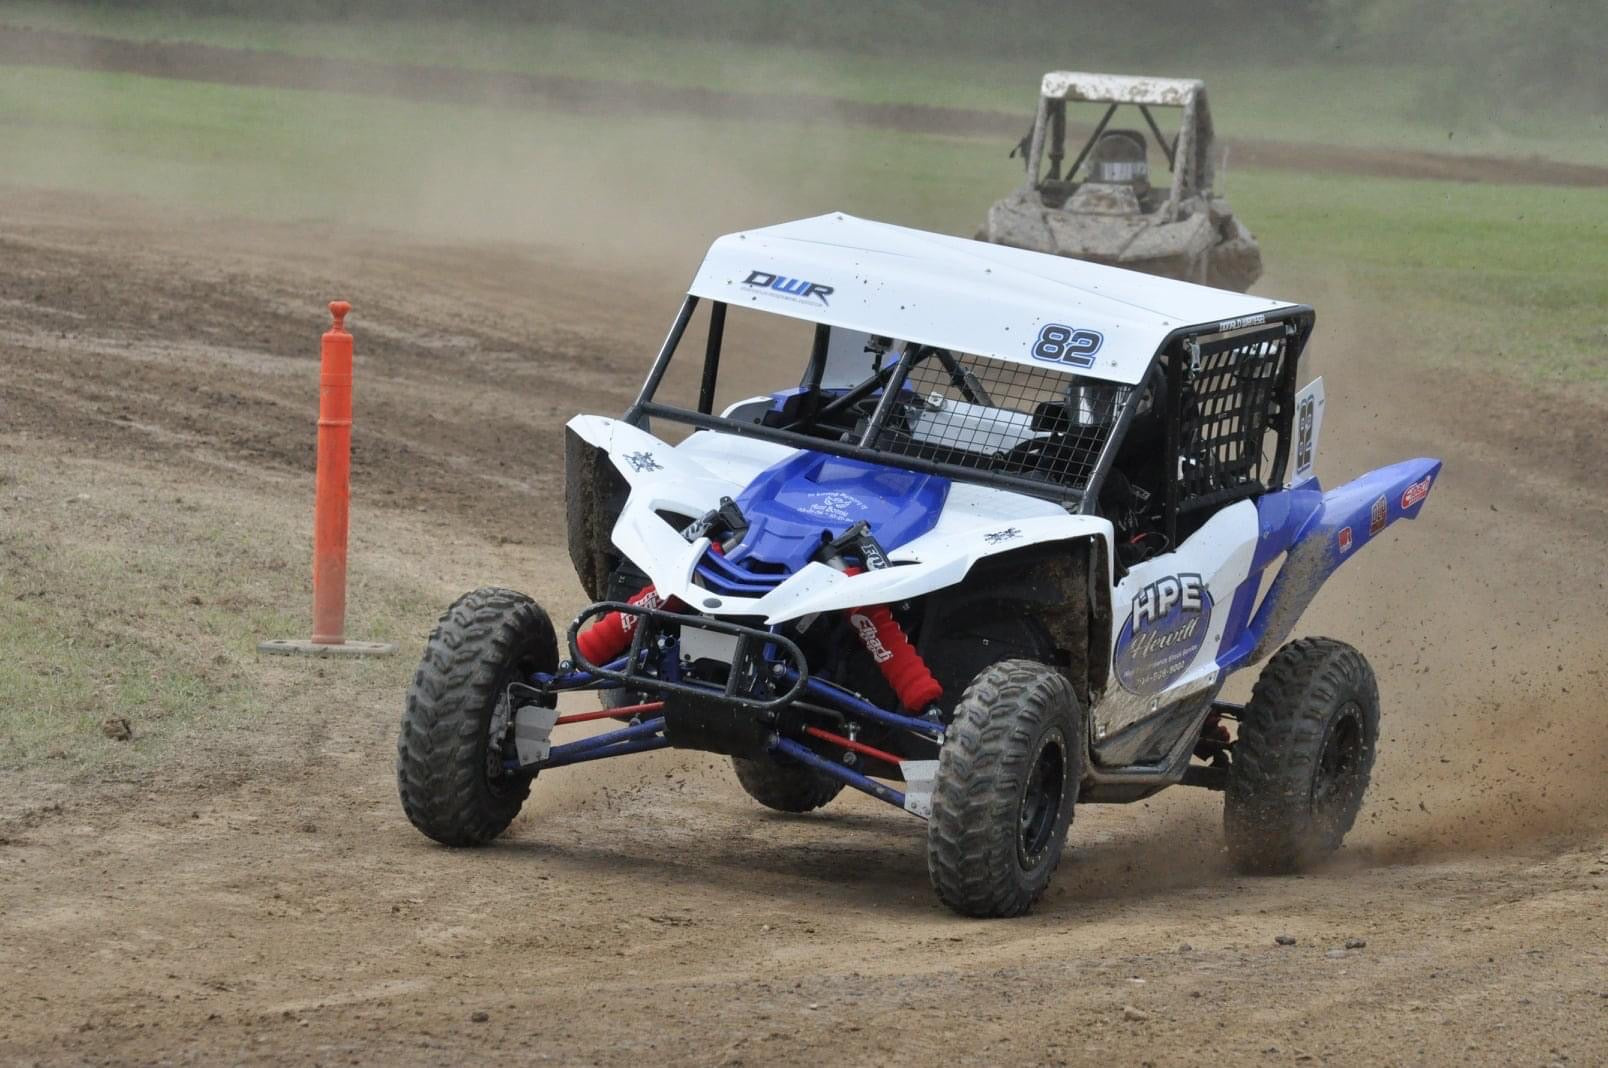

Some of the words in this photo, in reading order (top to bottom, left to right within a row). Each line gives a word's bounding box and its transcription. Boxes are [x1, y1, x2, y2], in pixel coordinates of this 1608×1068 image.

[741, 269, 835, 307] DWR
[1031, 323, 1104, 369] 82
[1131, 573, 1204, 637] HPE
